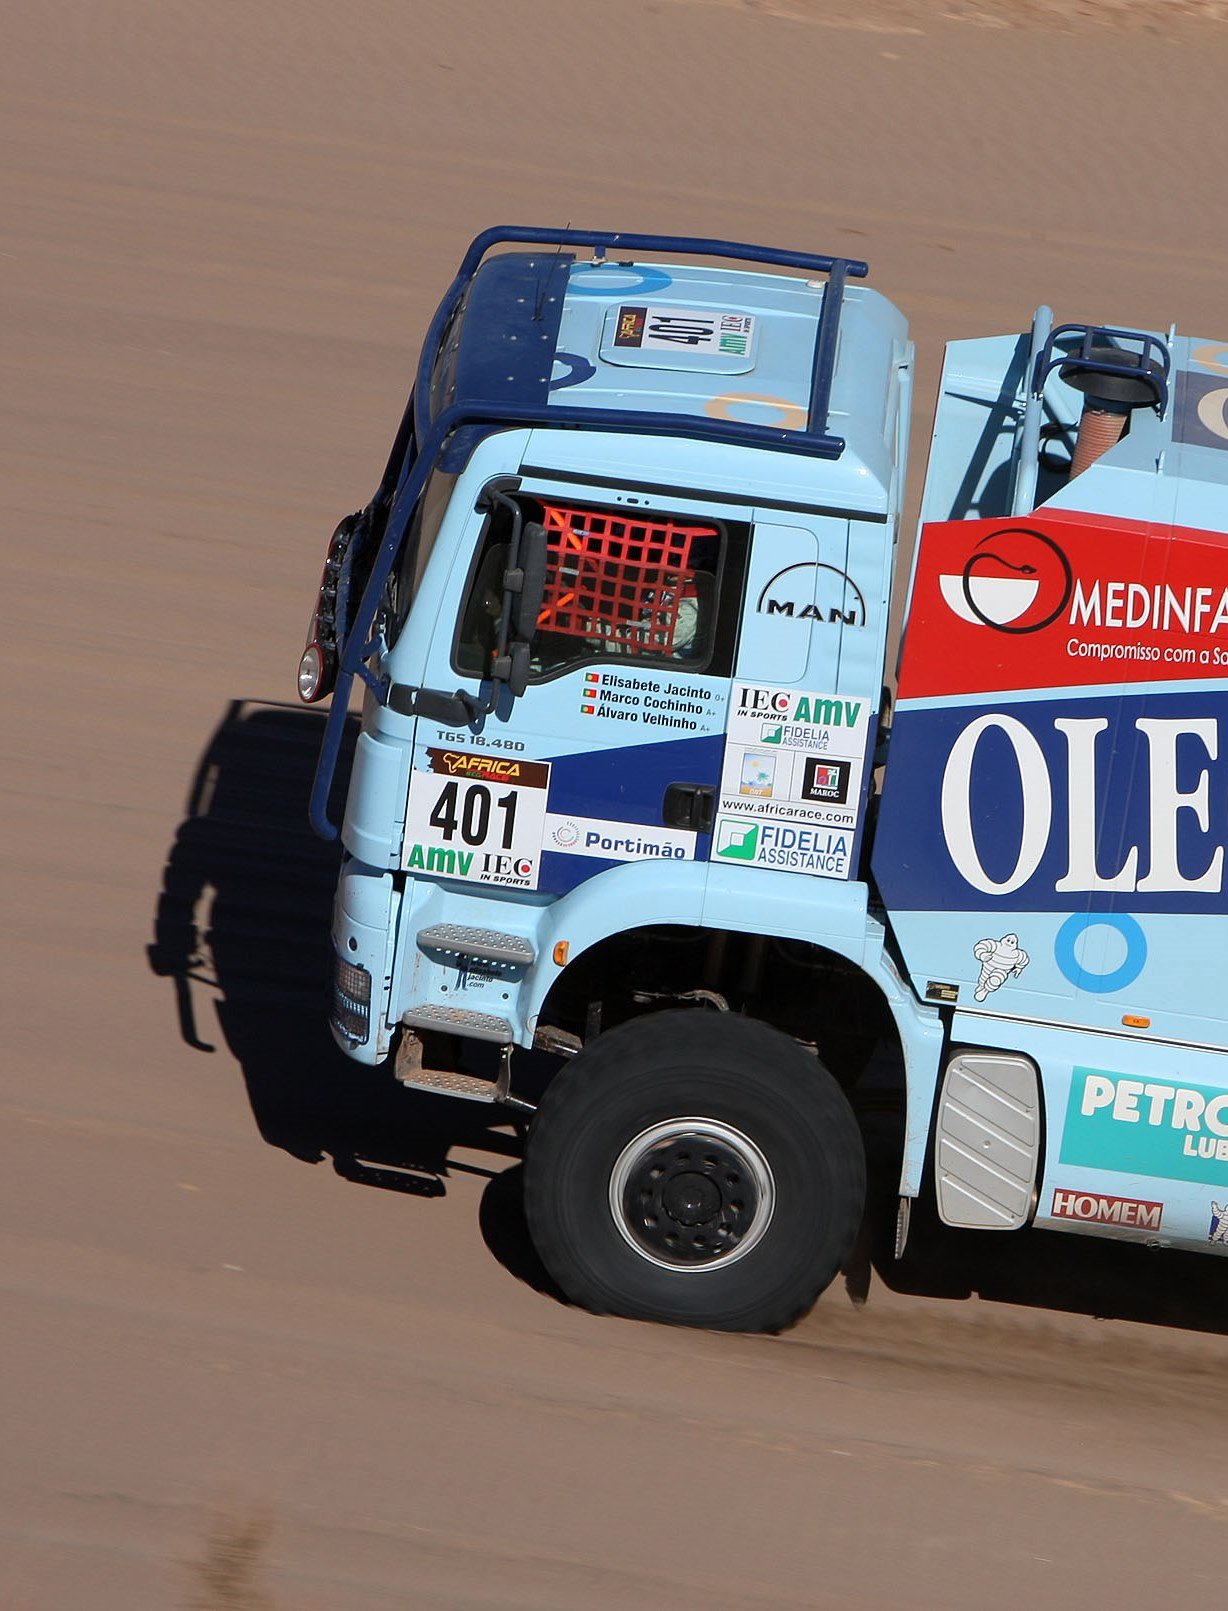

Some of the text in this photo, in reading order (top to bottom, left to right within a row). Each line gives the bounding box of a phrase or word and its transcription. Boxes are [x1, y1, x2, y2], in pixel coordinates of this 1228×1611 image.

[649, 316, 714, 345] 401
[720, 315, 743, 331] IEC
[766, 599, 857, 625] MAN
[1067, 638, 1160, 661] Compromisso
[1164, 649, 1196, 663] com
[1199, 651, 1210, 664] a
[602, 674, 660, 693] Elisabete
[664, 683, 711, 700] Jacinto
[739, 687, 791, 713] IEC
[599, 689, 640, 706] Marco
[643, 696, 703, 715] Cochinho
[597, 703, 638, 722] Álvaro
[642, 712, 697, 731] Velhinho
[736, 709, 788, 722] IN SPORTS
[436, 730, 525, 752] TGS 18.480
[782, 738, 828, 751] ASSISTANCE
[783, 725, 830, 741] FIDELIA
[453, 755, 520, 777] AFRICA
[810, 788, 840, 799] MAROC
[429, 781, 518, 850] 401
[722, 800, 854, 824] www.africarace.com
[585, 831, 686, 859] Portimão
[760, 825, 847, 857] FIDELIA
[481, 852, 533, 878] IEC
[757, 847, 845, 873] ASSISTANCE
[480, 873, 531, 887] IN SPORTS
[1052, 1192, 1162, 1228] HOMEM
